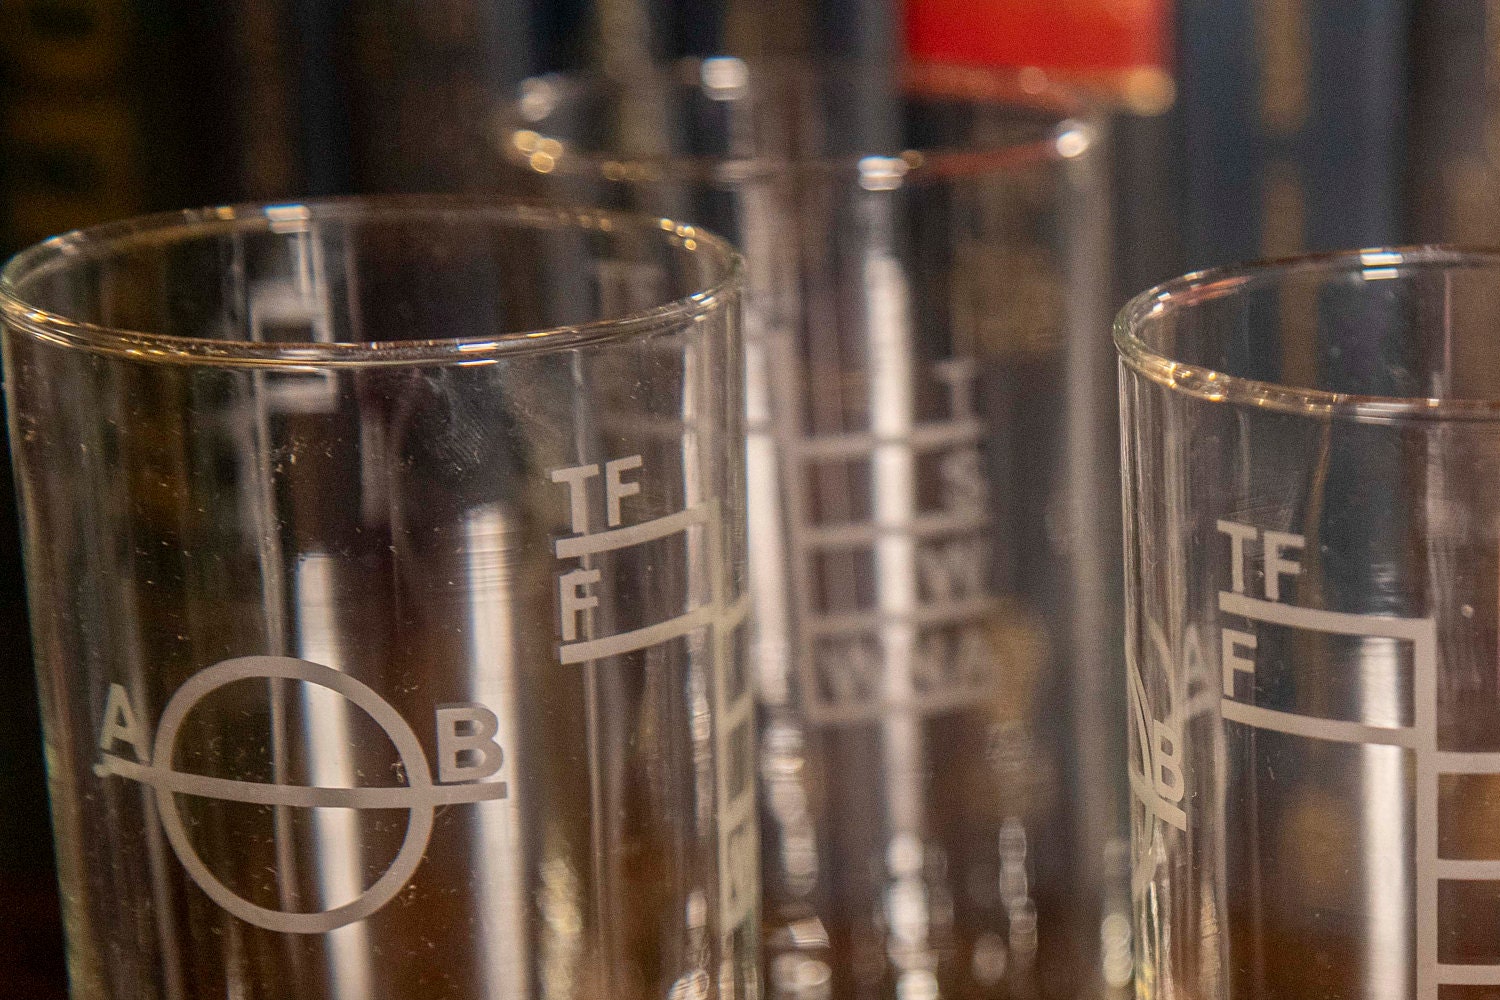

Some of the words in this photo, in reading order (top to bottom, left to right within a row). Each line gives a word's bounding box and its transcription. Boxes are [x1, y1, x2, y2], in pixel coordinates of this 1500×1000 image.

[551, 454, 643, 534] TF
[1216, 518, 1306, 600] TF
[558, 568, 601, 642] F
[1221, 626, 1258, 699] F
[100, 683, 147, 763] A
[434, 705, 504, 783] B
[1153, 717, 1186, 803] B
